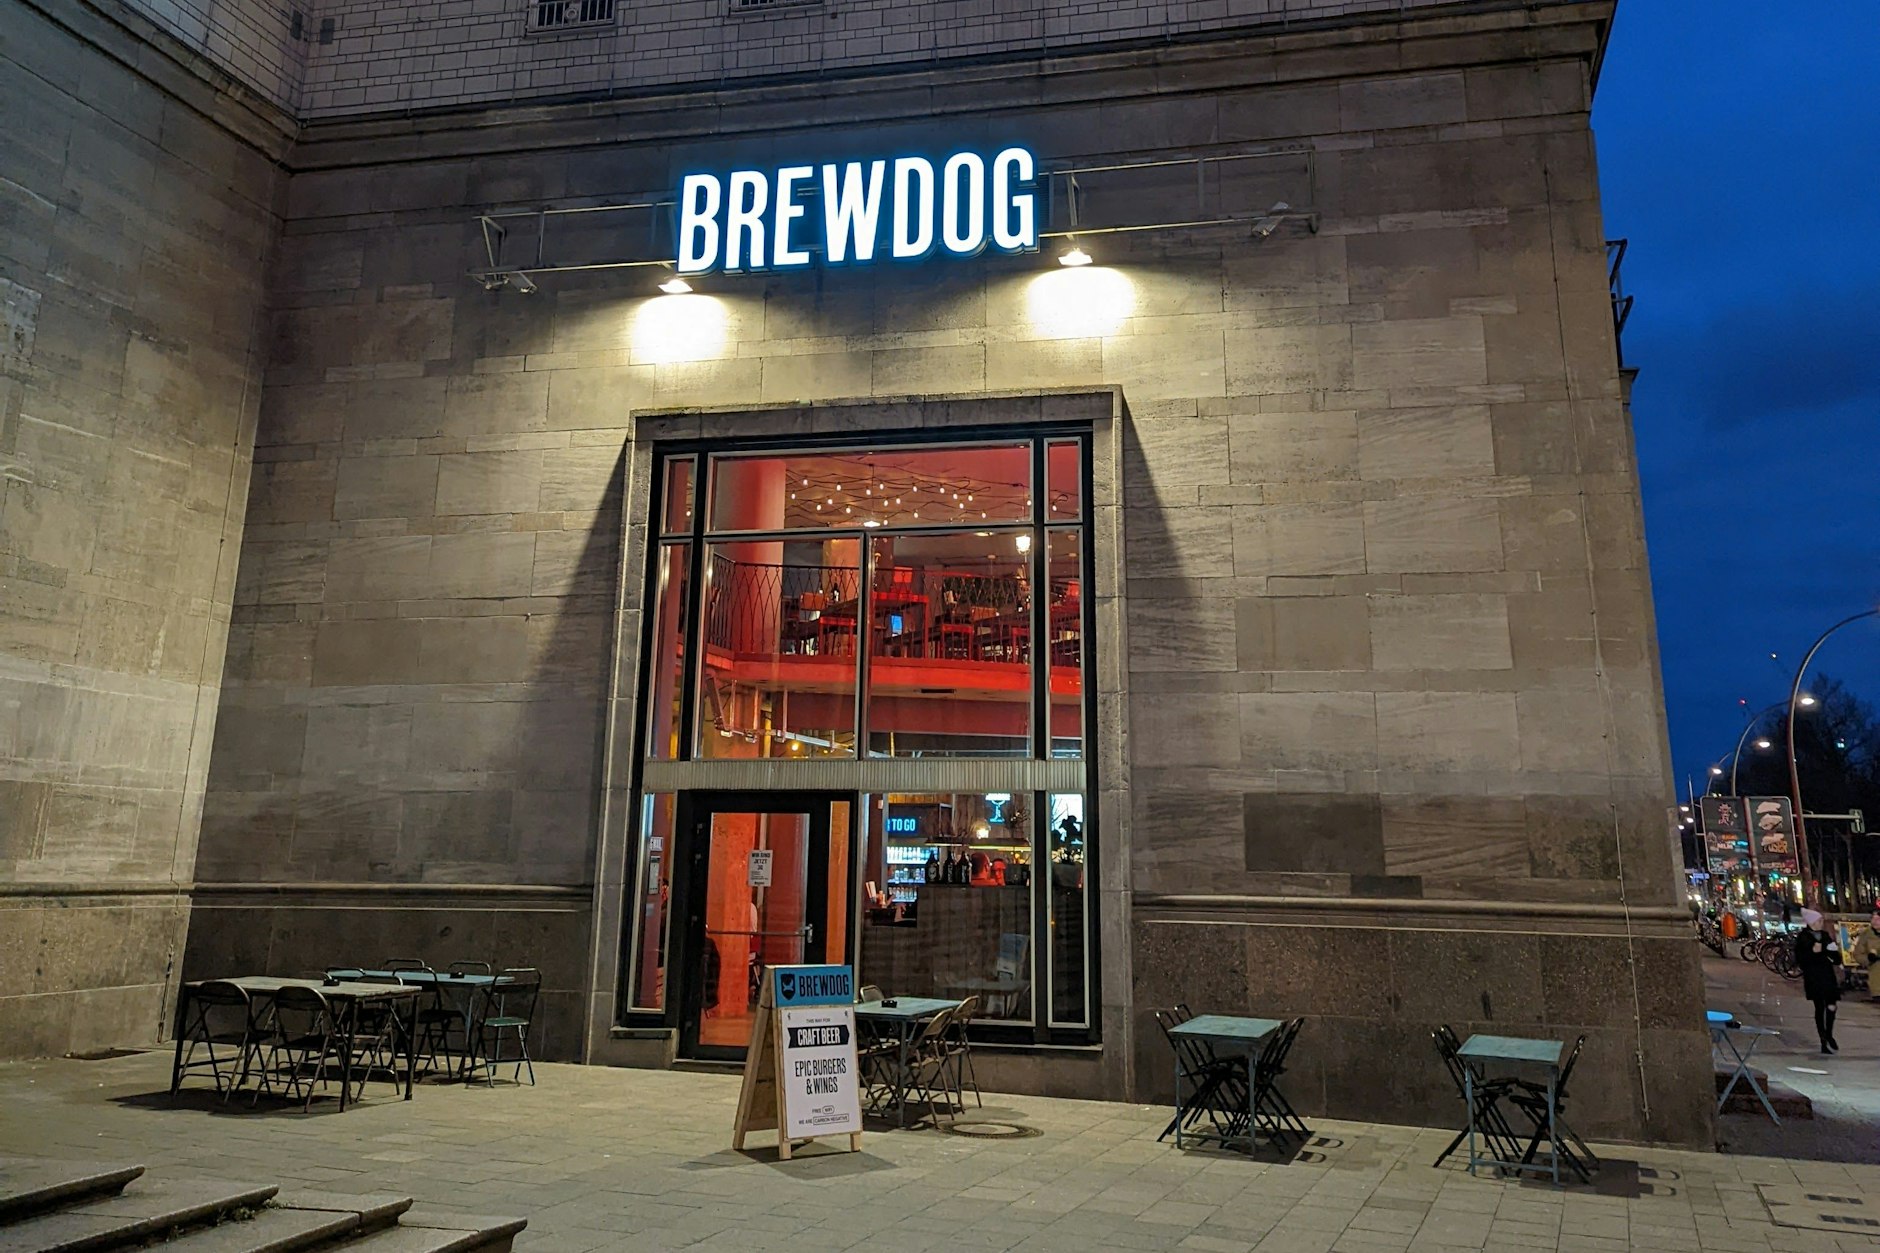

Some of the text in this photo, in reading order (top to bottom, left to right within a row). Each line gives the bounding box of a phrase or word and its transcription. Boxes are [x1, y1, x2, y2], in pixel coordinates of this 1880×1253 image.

[677, 147, 1036, 273] BREWDOG
[891, 818, 903, 832] TO
[903, 818, 916, 832] GO
[799, 974, 850, 998] BREWDOG
[797, 1027, 841, 1046] CRAFT BEER
[794, 1057, 847, 1077] EPIC BURGERS
[806, 1076, 838, 1095] & WINGS
